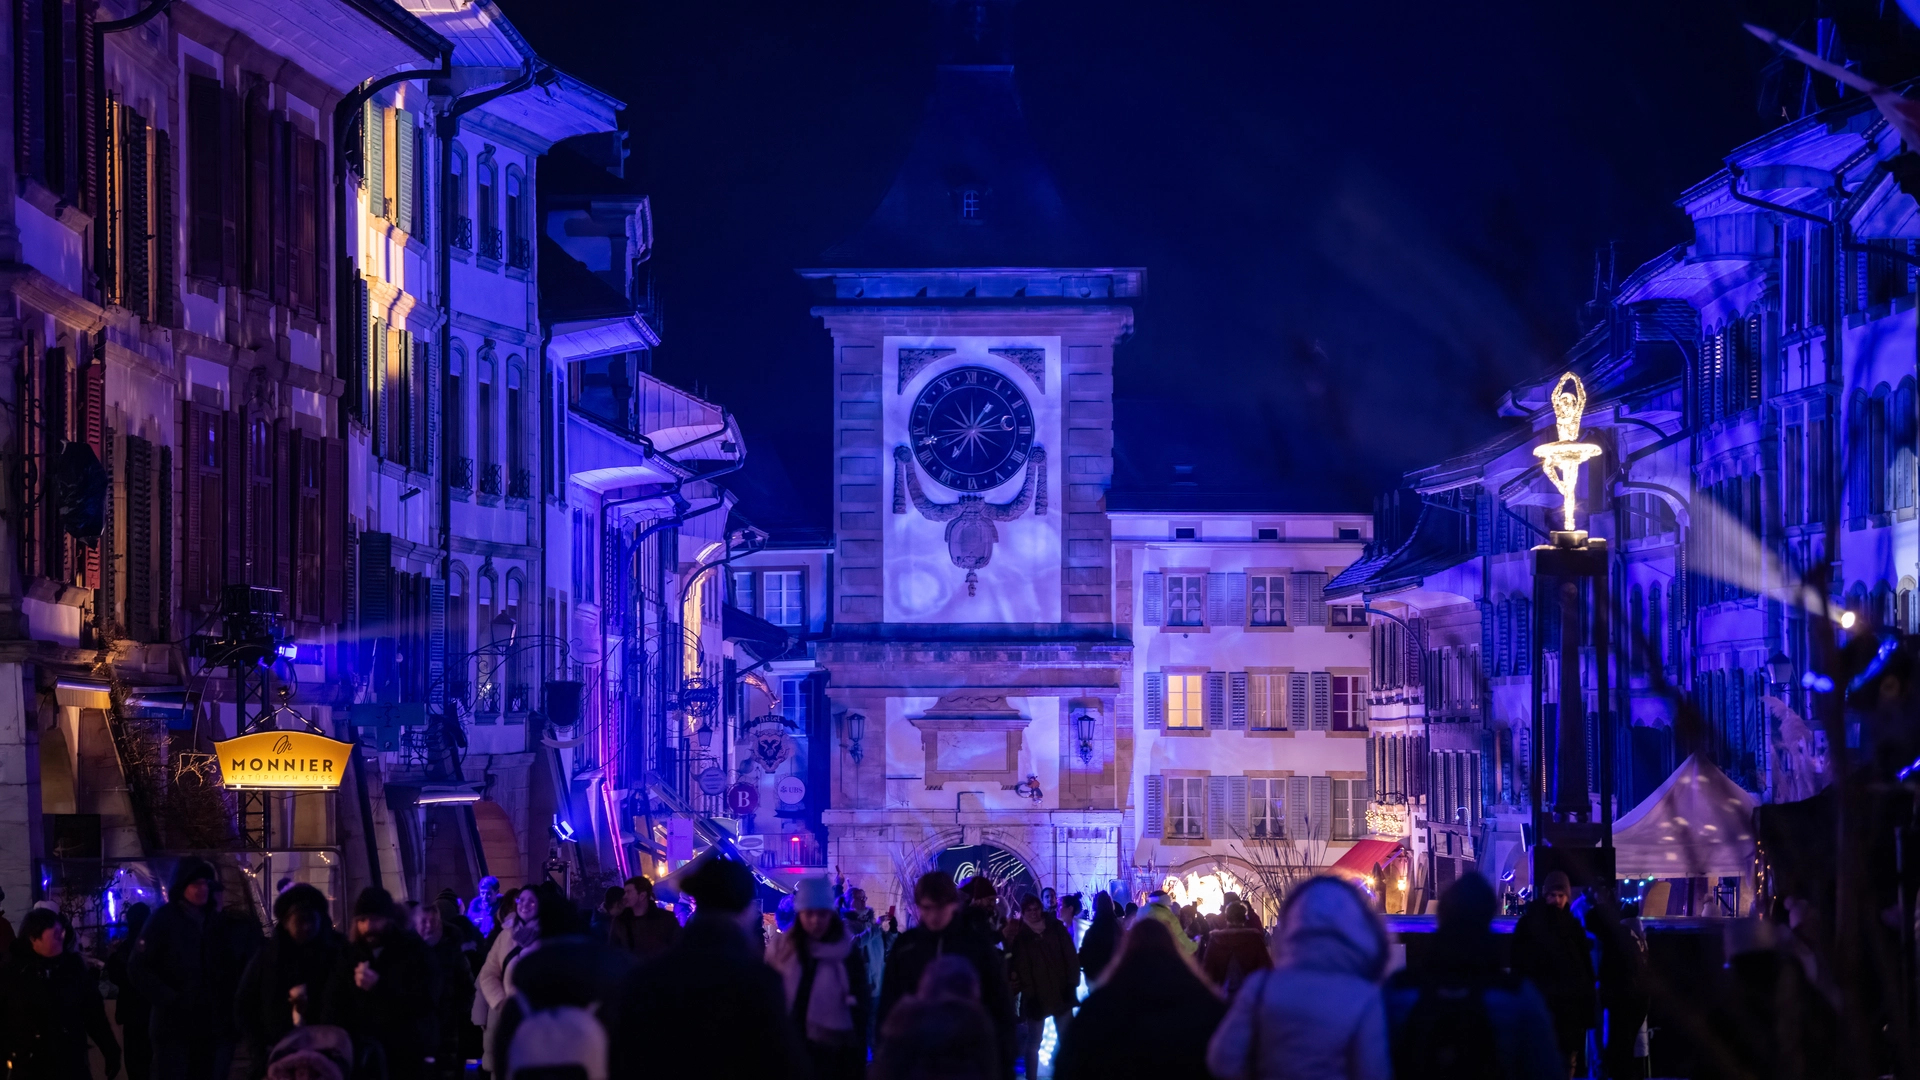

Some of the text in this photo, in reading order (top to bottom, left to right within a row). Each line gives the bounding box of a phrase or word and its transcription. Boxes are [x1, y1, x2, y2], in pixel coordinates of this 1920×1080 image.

[232, 758, 333, 772] MONNIER
[231, 774, 333, 782] NATÜRLICH SÜSS
[737, 790, 750, 808] B
